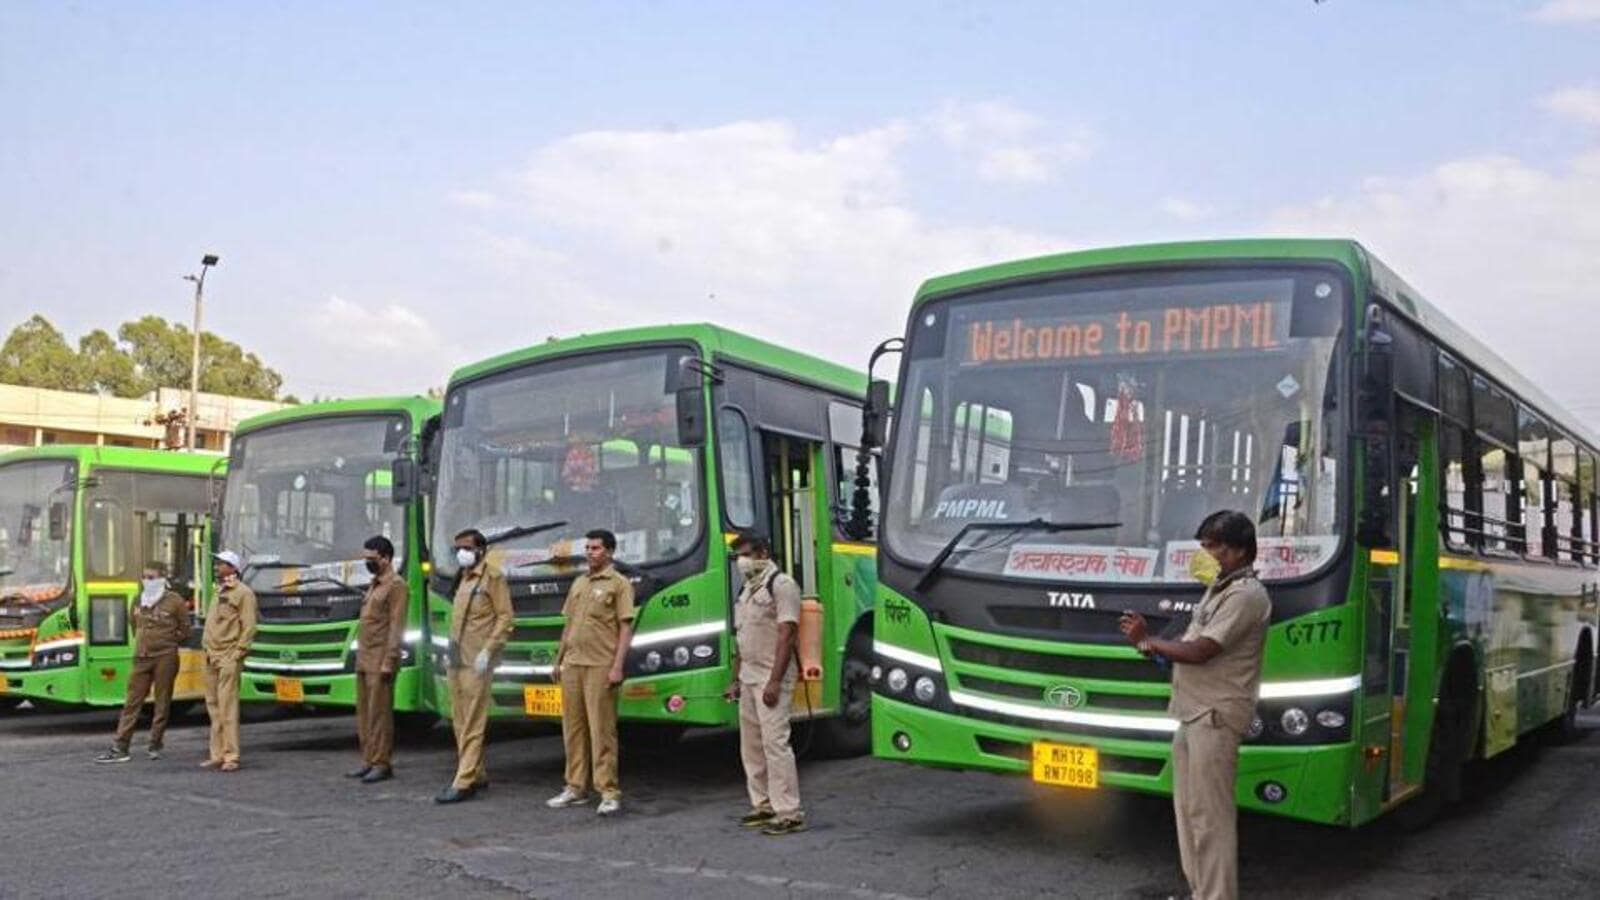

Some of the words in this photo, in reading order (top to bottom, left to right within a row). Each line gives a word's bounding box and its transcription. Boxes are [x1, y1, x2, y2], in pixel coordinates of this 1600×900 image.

[972, 319, 1102, 361] Welcome
[1116, 310, 1151, 355] to
[1163, 301, 1279, 352] PMPML
[934, 499, 1008, 519] PMPML
[1047, 591, 1095, 609] TATA
